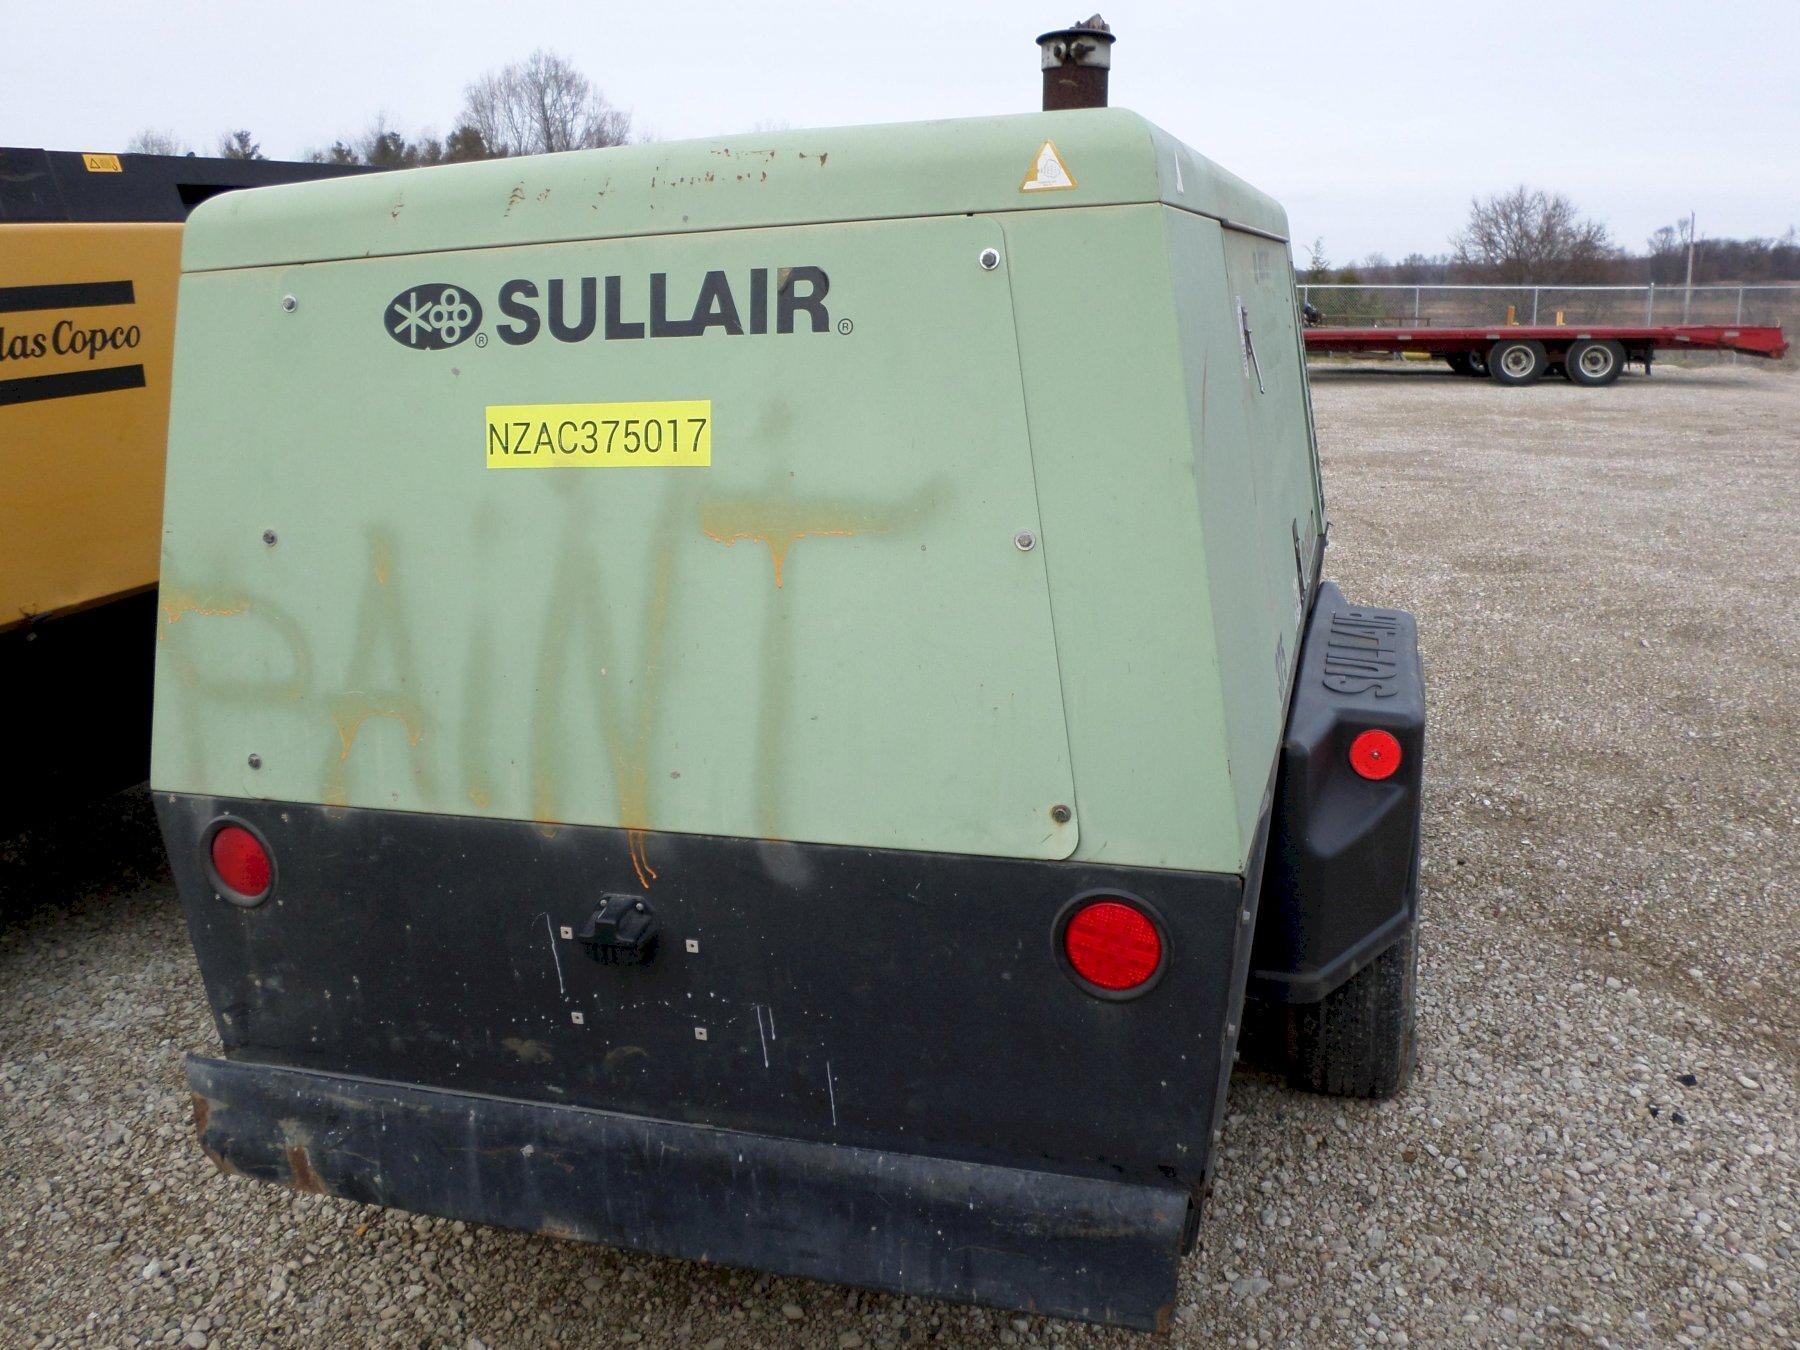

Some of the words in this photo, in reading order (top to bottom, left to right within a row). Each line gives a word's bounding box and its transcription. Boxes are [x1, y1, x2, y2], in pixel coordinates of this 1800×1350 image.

[496, 266, 830, 346] SULLAIR
[52, 320, 141, 360] Copco
[488, 417, 707, 455] NZAC375017
